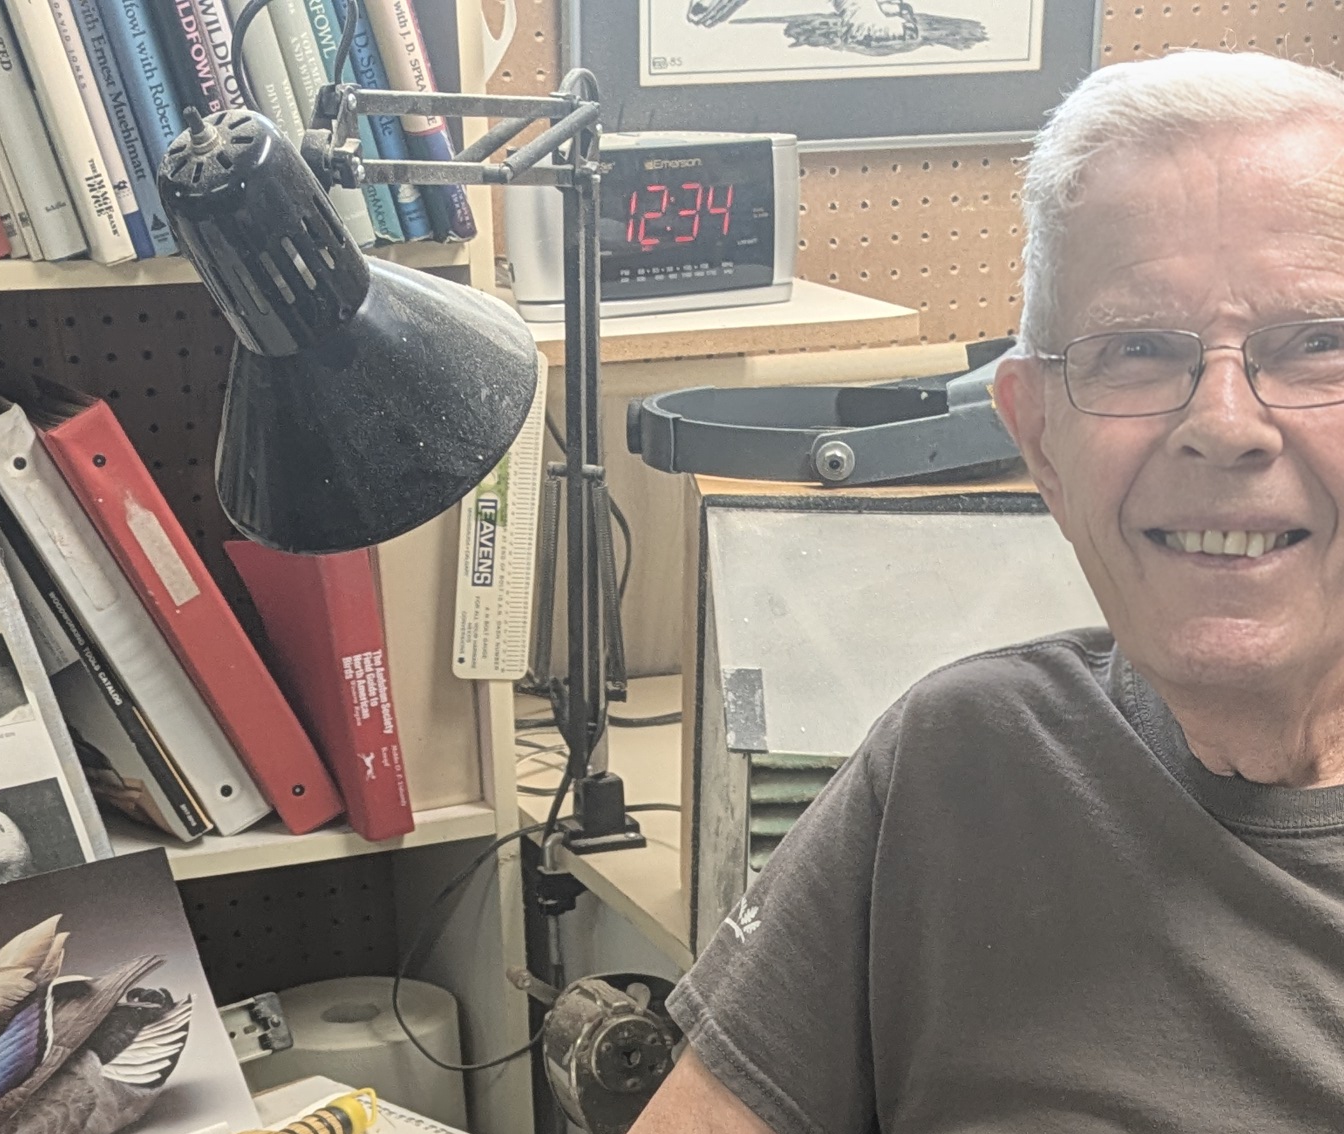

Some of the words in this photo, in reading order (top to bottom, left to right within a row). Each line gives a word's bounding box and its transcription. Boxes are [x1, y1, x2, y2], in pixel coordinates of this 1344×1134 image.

[136, 41, 154, 81] with
[148, 83, 174, 138] Robert
[653, 158, 702, 170] Emerson
[626, 181, 733, 246] 12:34
[474, 499, 497, 586] LEAVENS
[363, 652, 373, 672] Field
[372, 650, 383, 666] The
[375, 667, 388, 703] Audubon
[381, 703, 394, 734] Society
